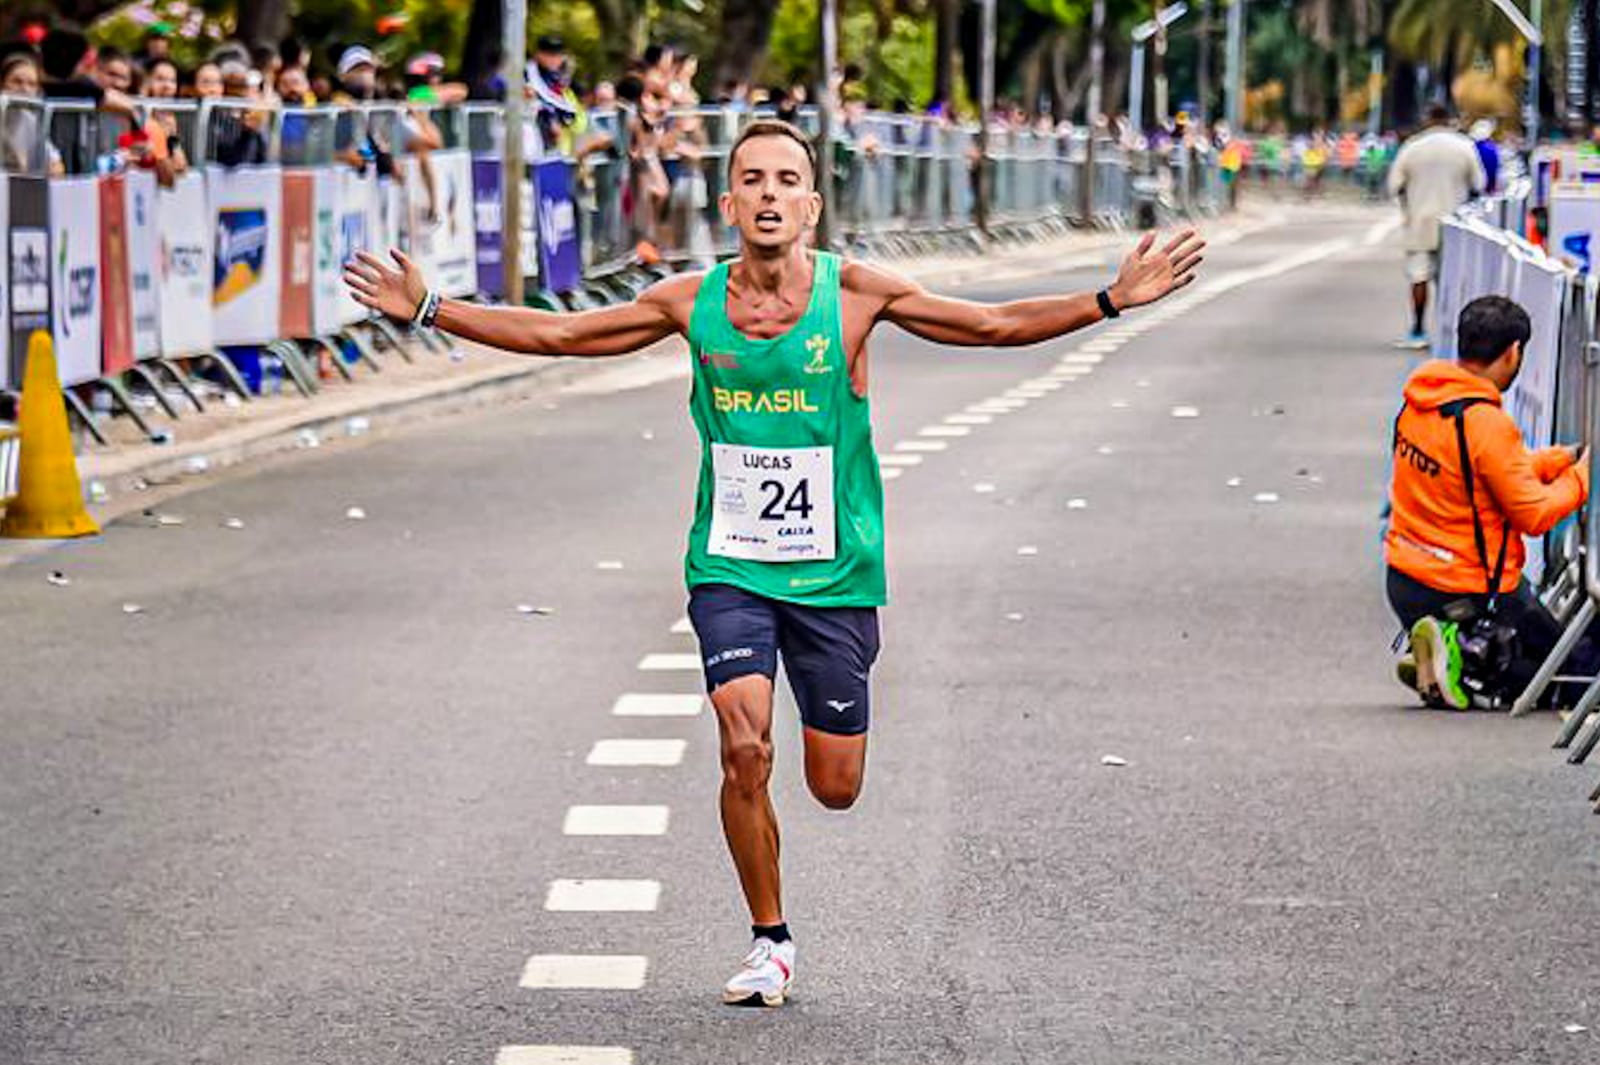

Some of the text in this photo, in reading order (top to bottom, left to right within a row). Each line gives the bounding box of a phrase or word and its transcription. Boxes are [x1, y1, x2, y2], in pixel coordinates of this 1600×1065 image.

[712, 386, 819, 412] BRASIL
[743, 453, 792, 471] LUCAS
[759, 478, 814, 521] 24
